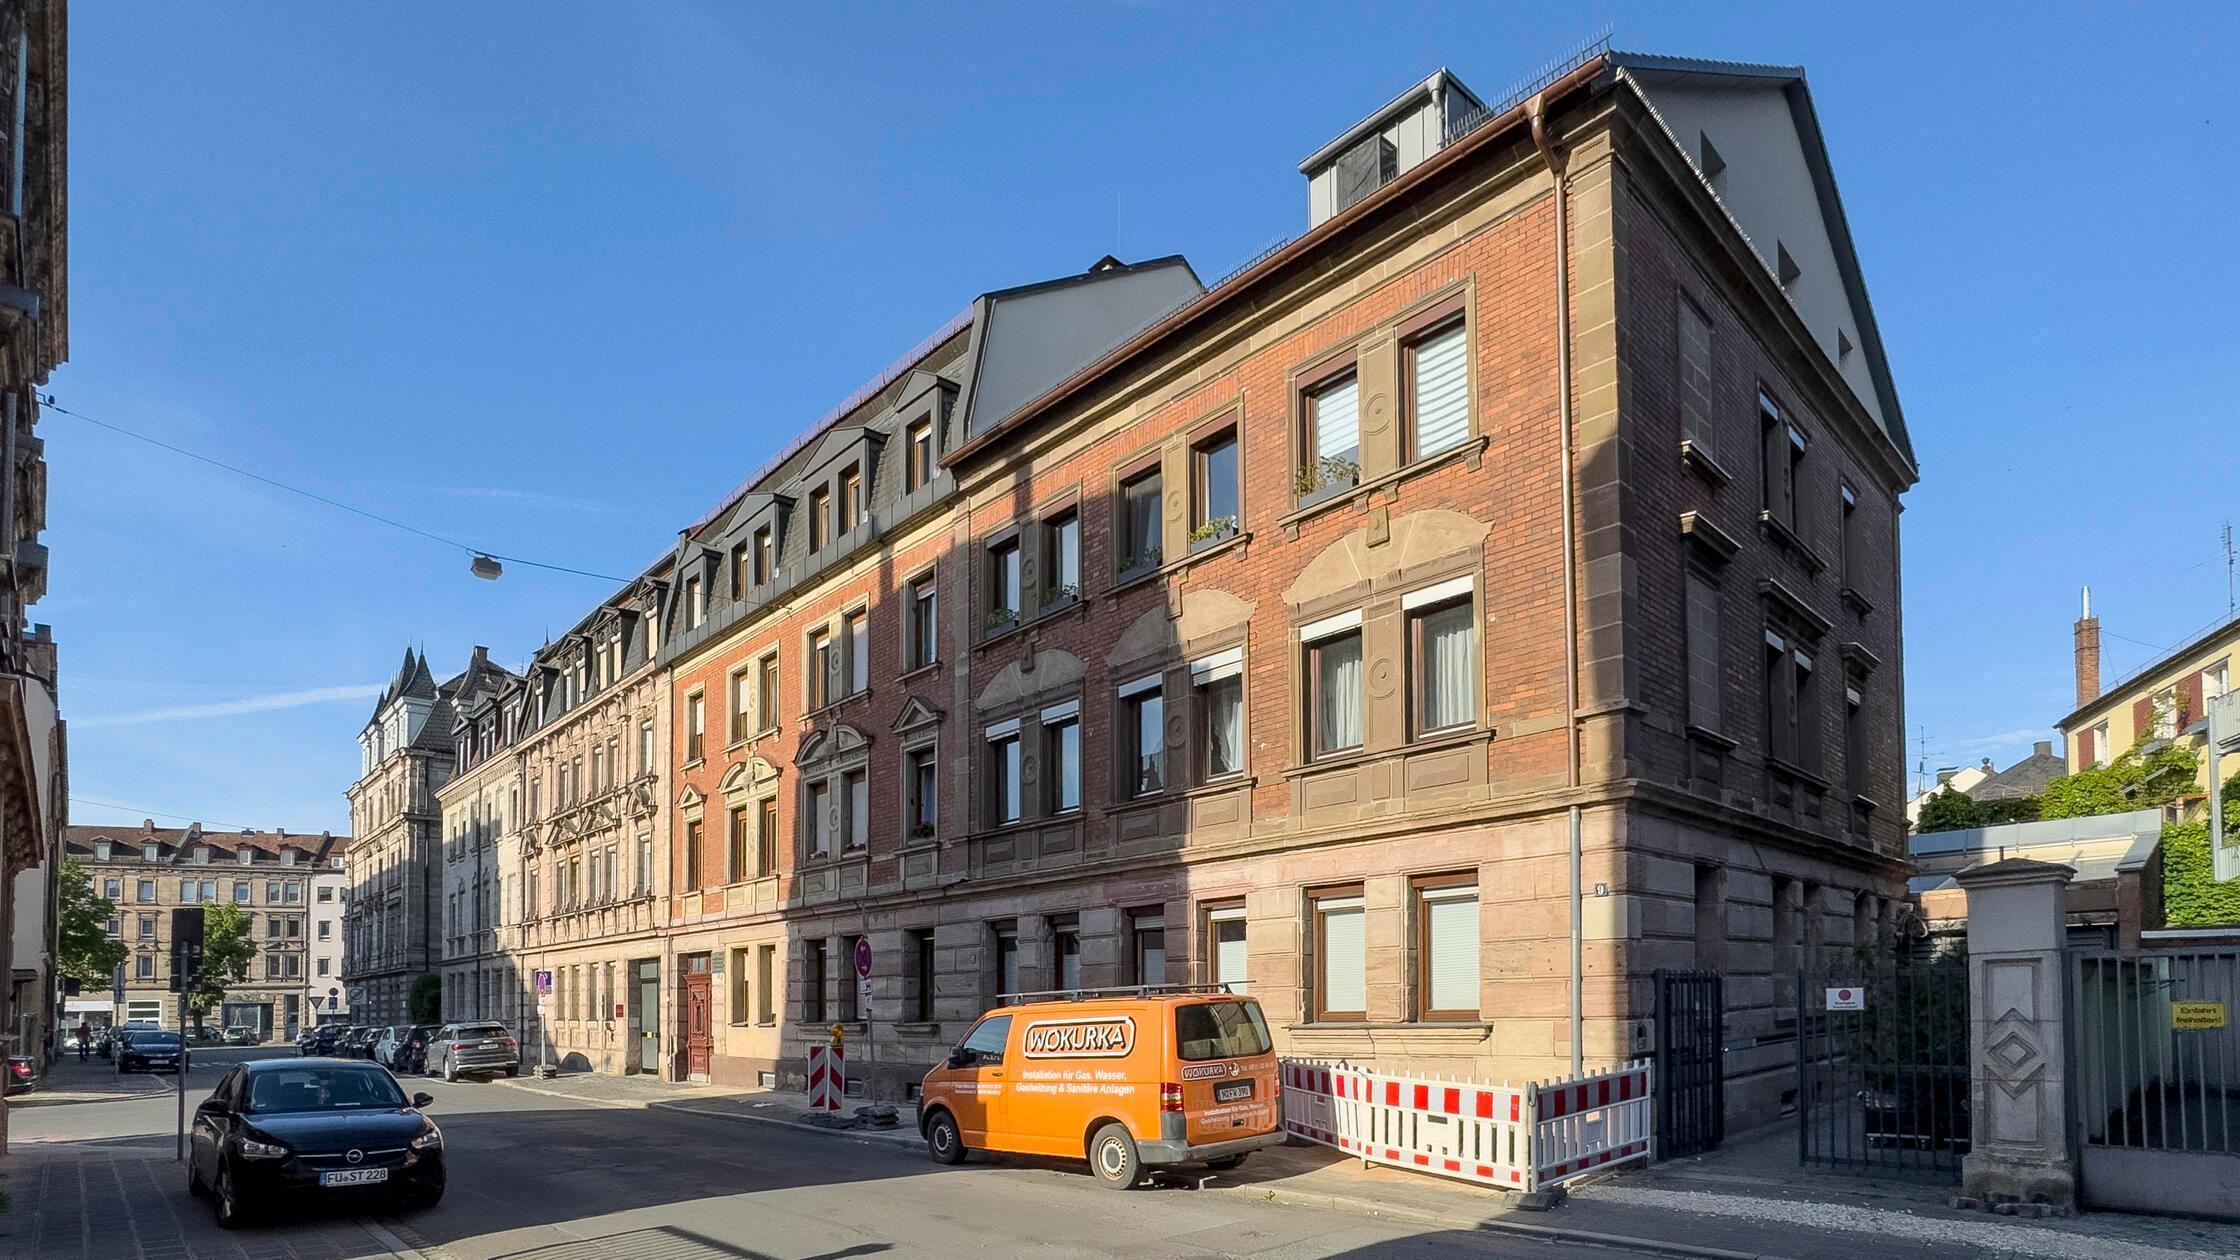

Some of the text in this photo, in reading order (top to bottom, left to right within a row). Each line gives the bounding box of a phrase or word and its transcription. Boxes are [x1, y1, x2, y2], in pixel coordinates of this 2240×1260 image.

[1596, 884, 1605, 896] 9
[1030, 1025, 1126, 1052] WOKURKA
[1022, 1069, 1127, 1082] Installation für Gas, Wasser,
[1184, 1066, 1224, 1079] WOKURKA
[1016, 1082, 1135, 1096] Gasheizung & Sanitäre Anlagen
[349, 1171, 365, 1181] ST
[366, 1169, 386, 1180] 228
